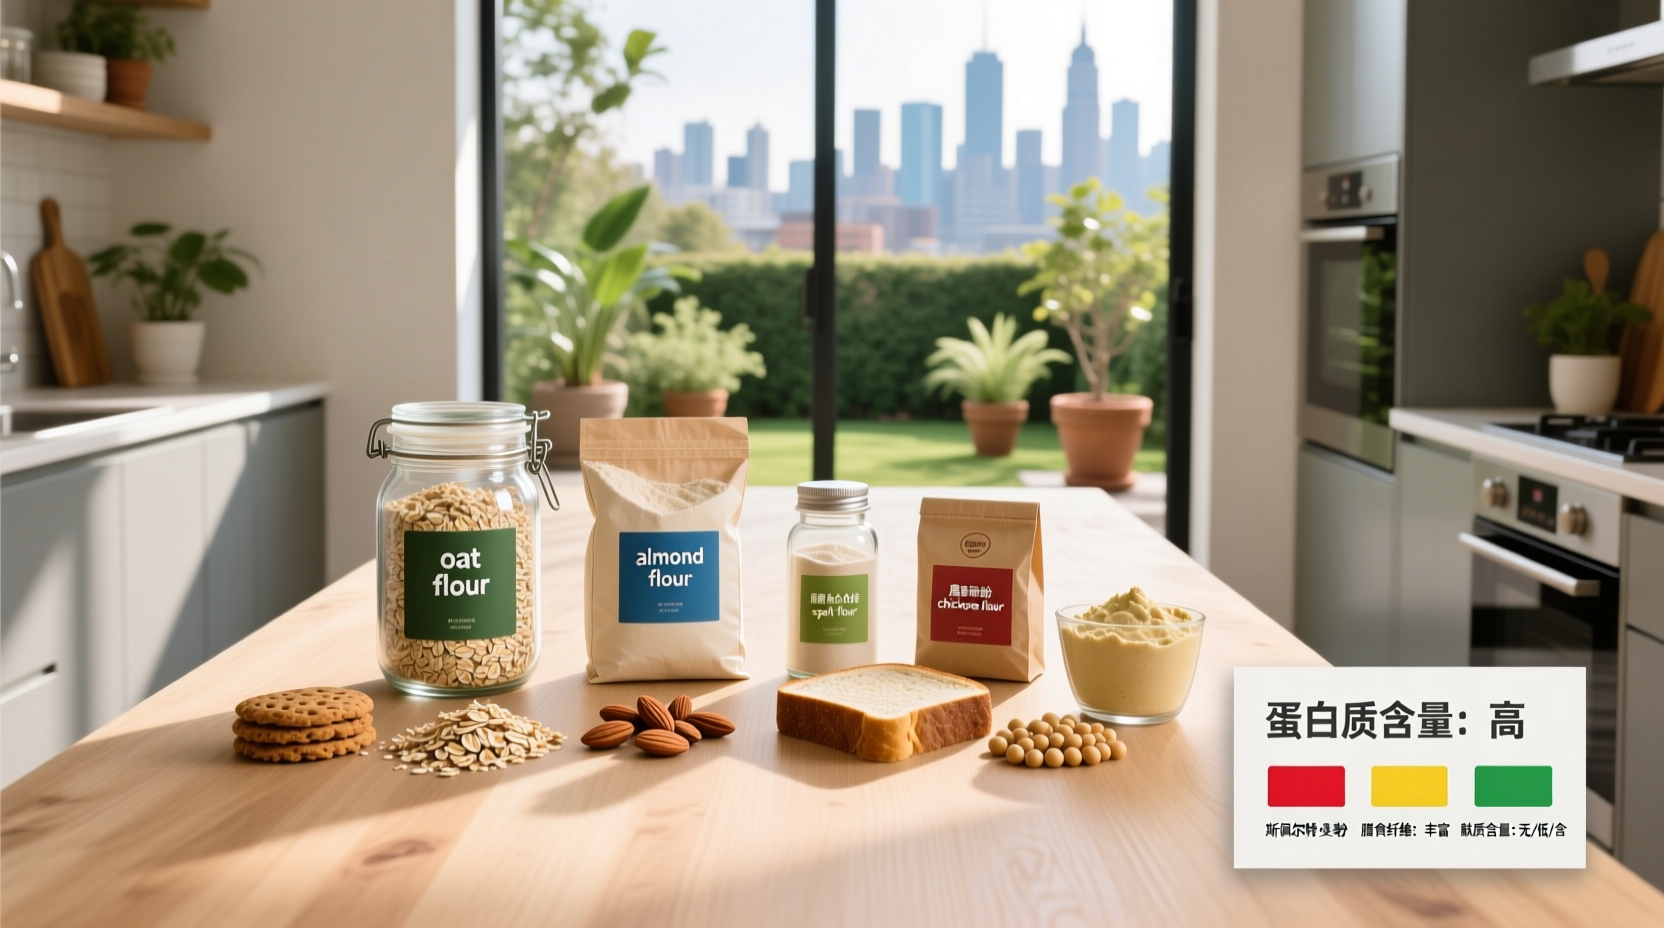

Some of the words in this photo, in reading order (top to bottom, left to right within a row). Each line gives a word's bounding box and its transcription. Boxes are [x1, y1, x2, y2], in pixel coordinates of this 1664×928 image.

[440, 548, 482, 569] oat
[635, 546, 704, 567] almond
[432, 573, 491, 597] flour
[648, 568, 693, 587] flour
